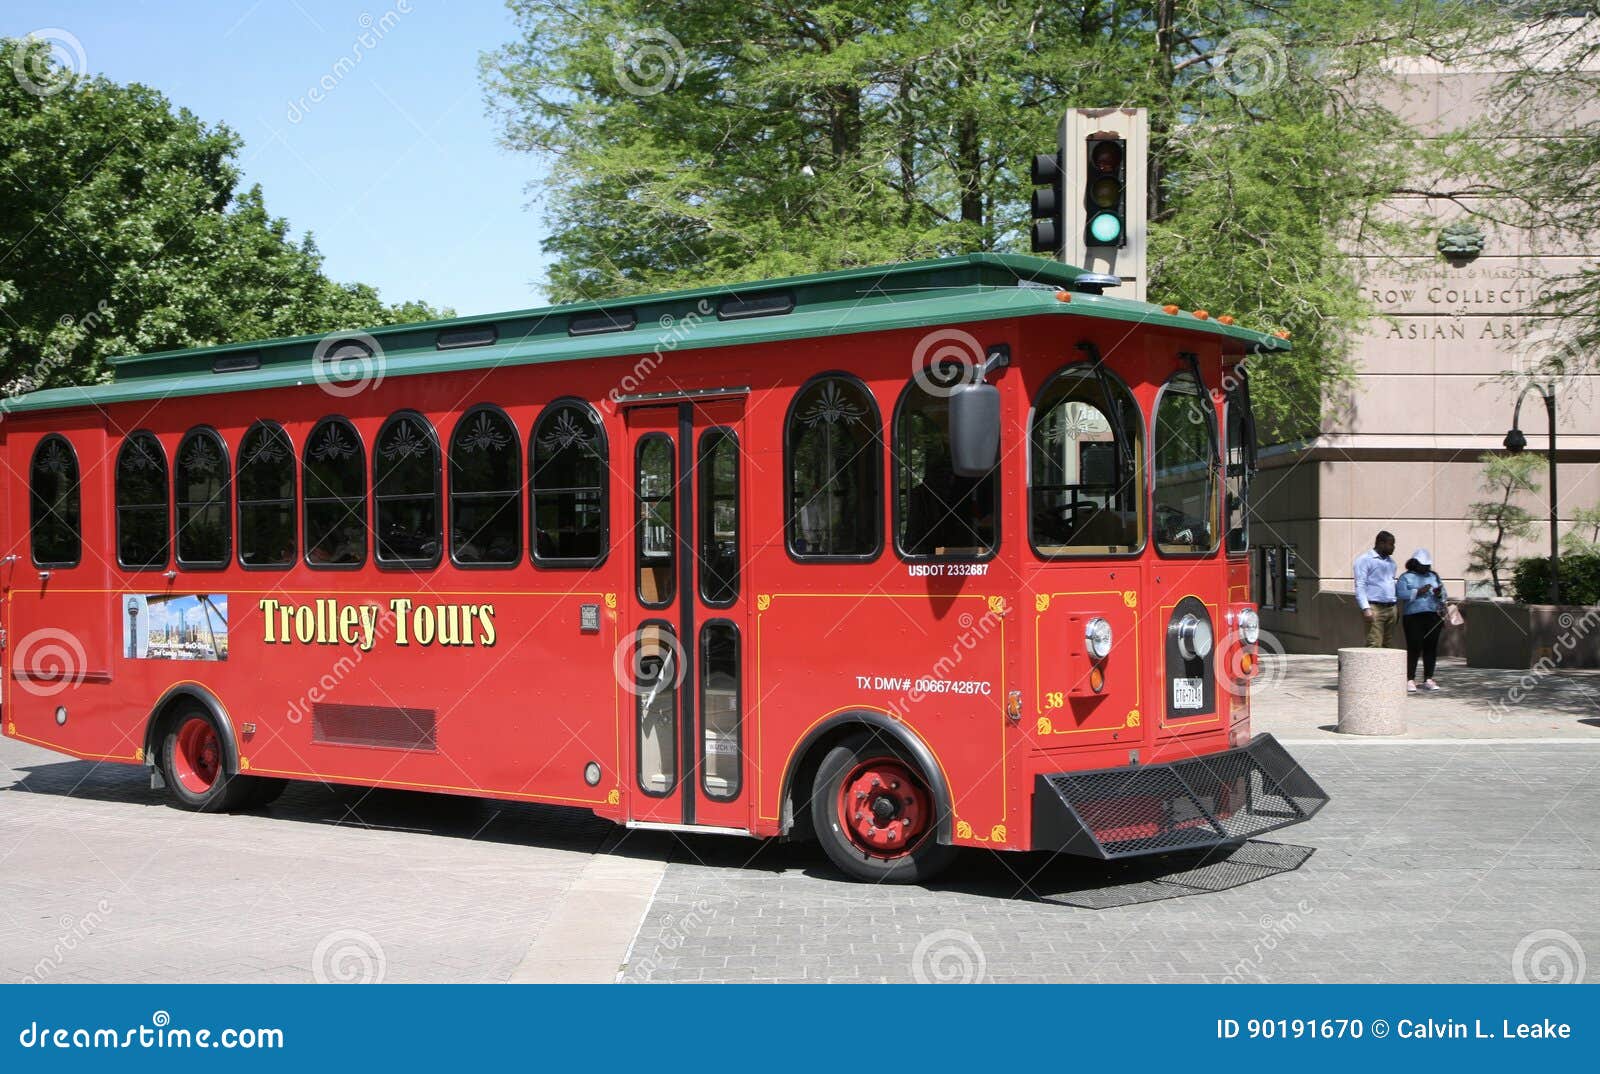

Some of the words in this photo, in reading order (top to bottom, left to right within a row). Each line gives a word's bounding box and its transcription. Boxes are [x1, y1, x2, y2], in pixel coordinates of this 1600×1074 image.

[1427, 287, 1560, 304] COLLECTIO
[1385, 322, 1466, 340] ASIAN
[908, 564, 945, 577] USDOT
[947, 564, 989, 576] 2332687
[259, 598, 379, 650] Trolley
[390, 598, 497, 647] Tours
[856, 676, 872, 689] TX
[874, 677, 911, 691] DMV#
[914, 680, 992, 695] 006674287C
[1044, 692, 1064, 709] 38
